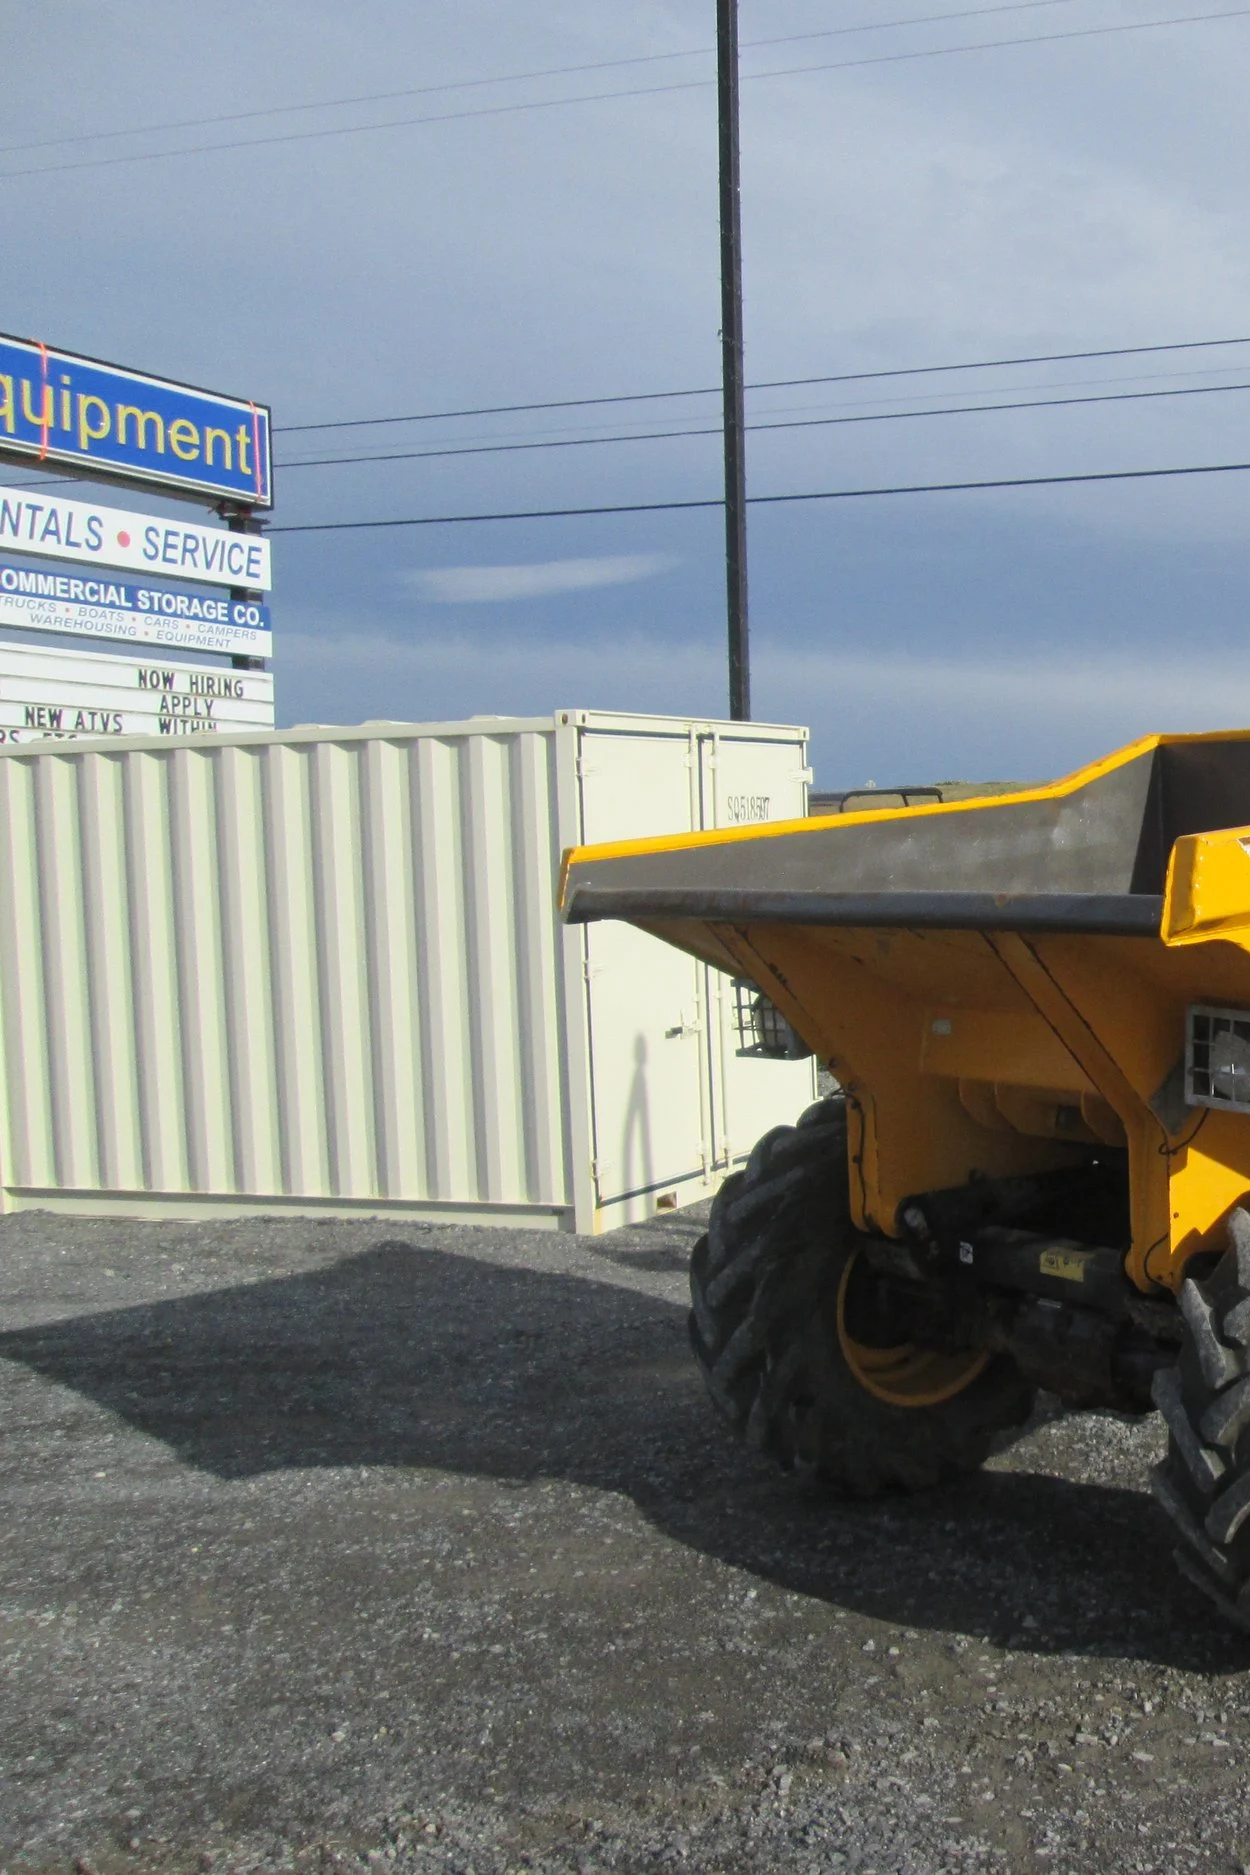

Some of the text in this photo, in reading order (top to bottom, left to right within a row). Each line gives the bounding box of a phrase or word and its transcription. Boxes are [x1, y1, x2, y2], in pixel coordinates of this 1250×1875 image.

[0, 499, 263, 579] NTALS SERVICE
[0, 568, 264, 627] OMMERCIAL STORAGE CO.
[30, 613, 231, 648] WAREHOUSING EQUIPMENT
[78, 607, 125, 622] BOATS
[144, 616, 179, 630] CARS
[197, 624, 257, 641] CAMPERS
[138, 668, 244, 698] NOW HIRING
[25, 706, 123, 734] NEW ATVS
[160, 694, 214, 717] APPLY
[159, 717, 217, 734] WITHIN
